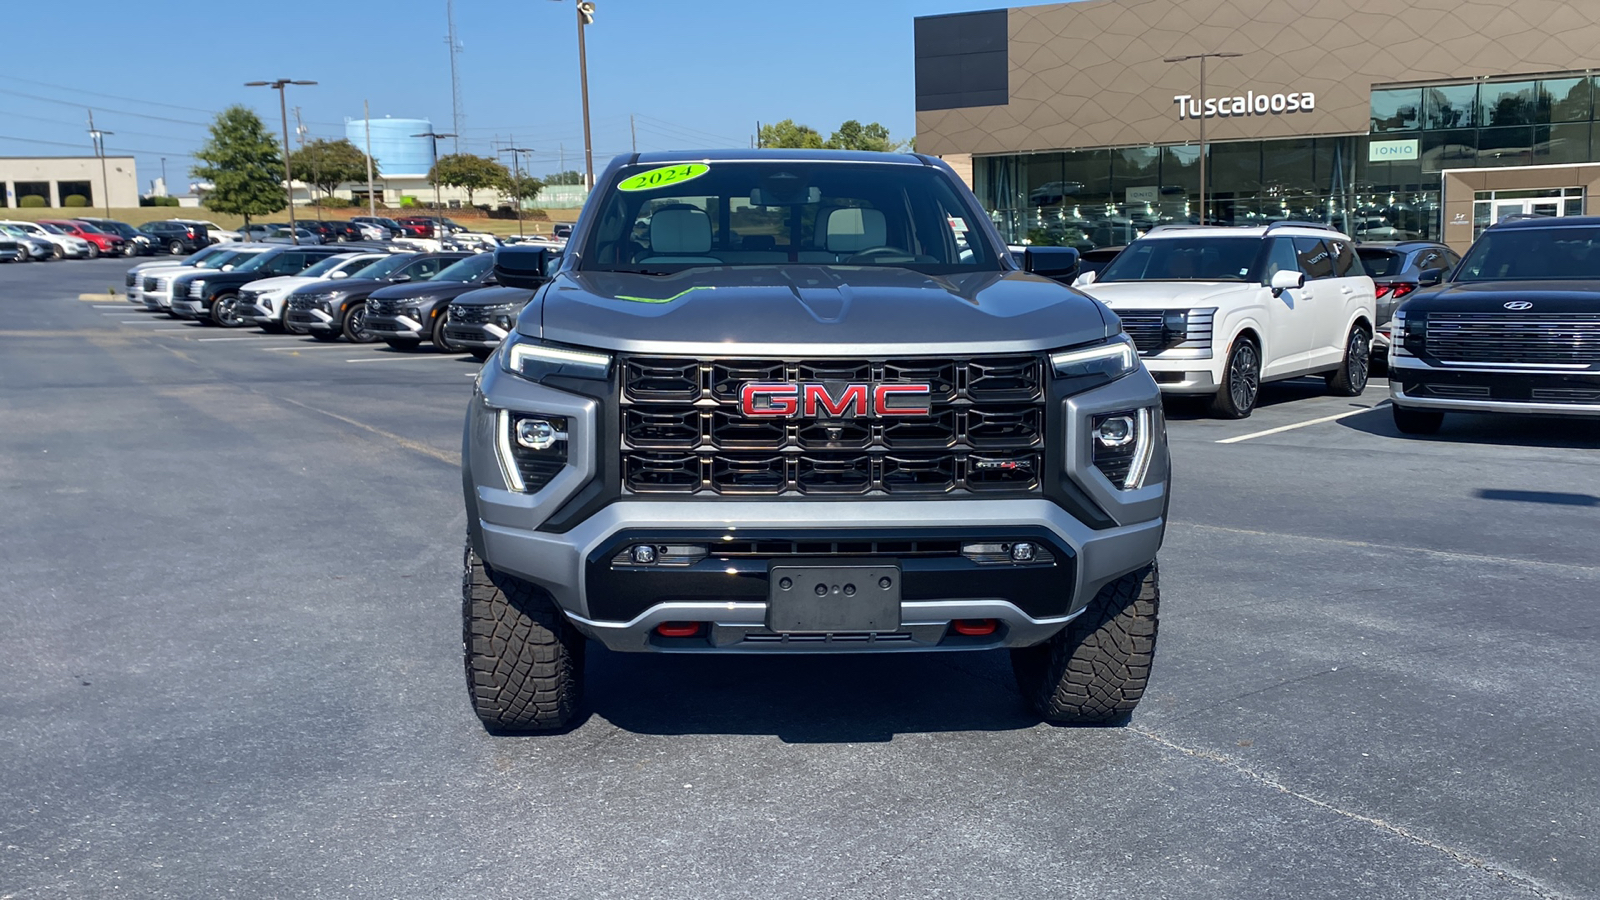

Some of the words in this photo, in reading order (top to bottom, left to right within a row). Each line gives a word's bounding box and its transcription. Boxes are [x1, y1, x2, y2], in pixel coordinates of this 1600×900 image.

[1173, 90, 1315, 119] Tuscaloosa
[634, 165, 693, 189] 2024
[740, 383, 931, 418] GMC
